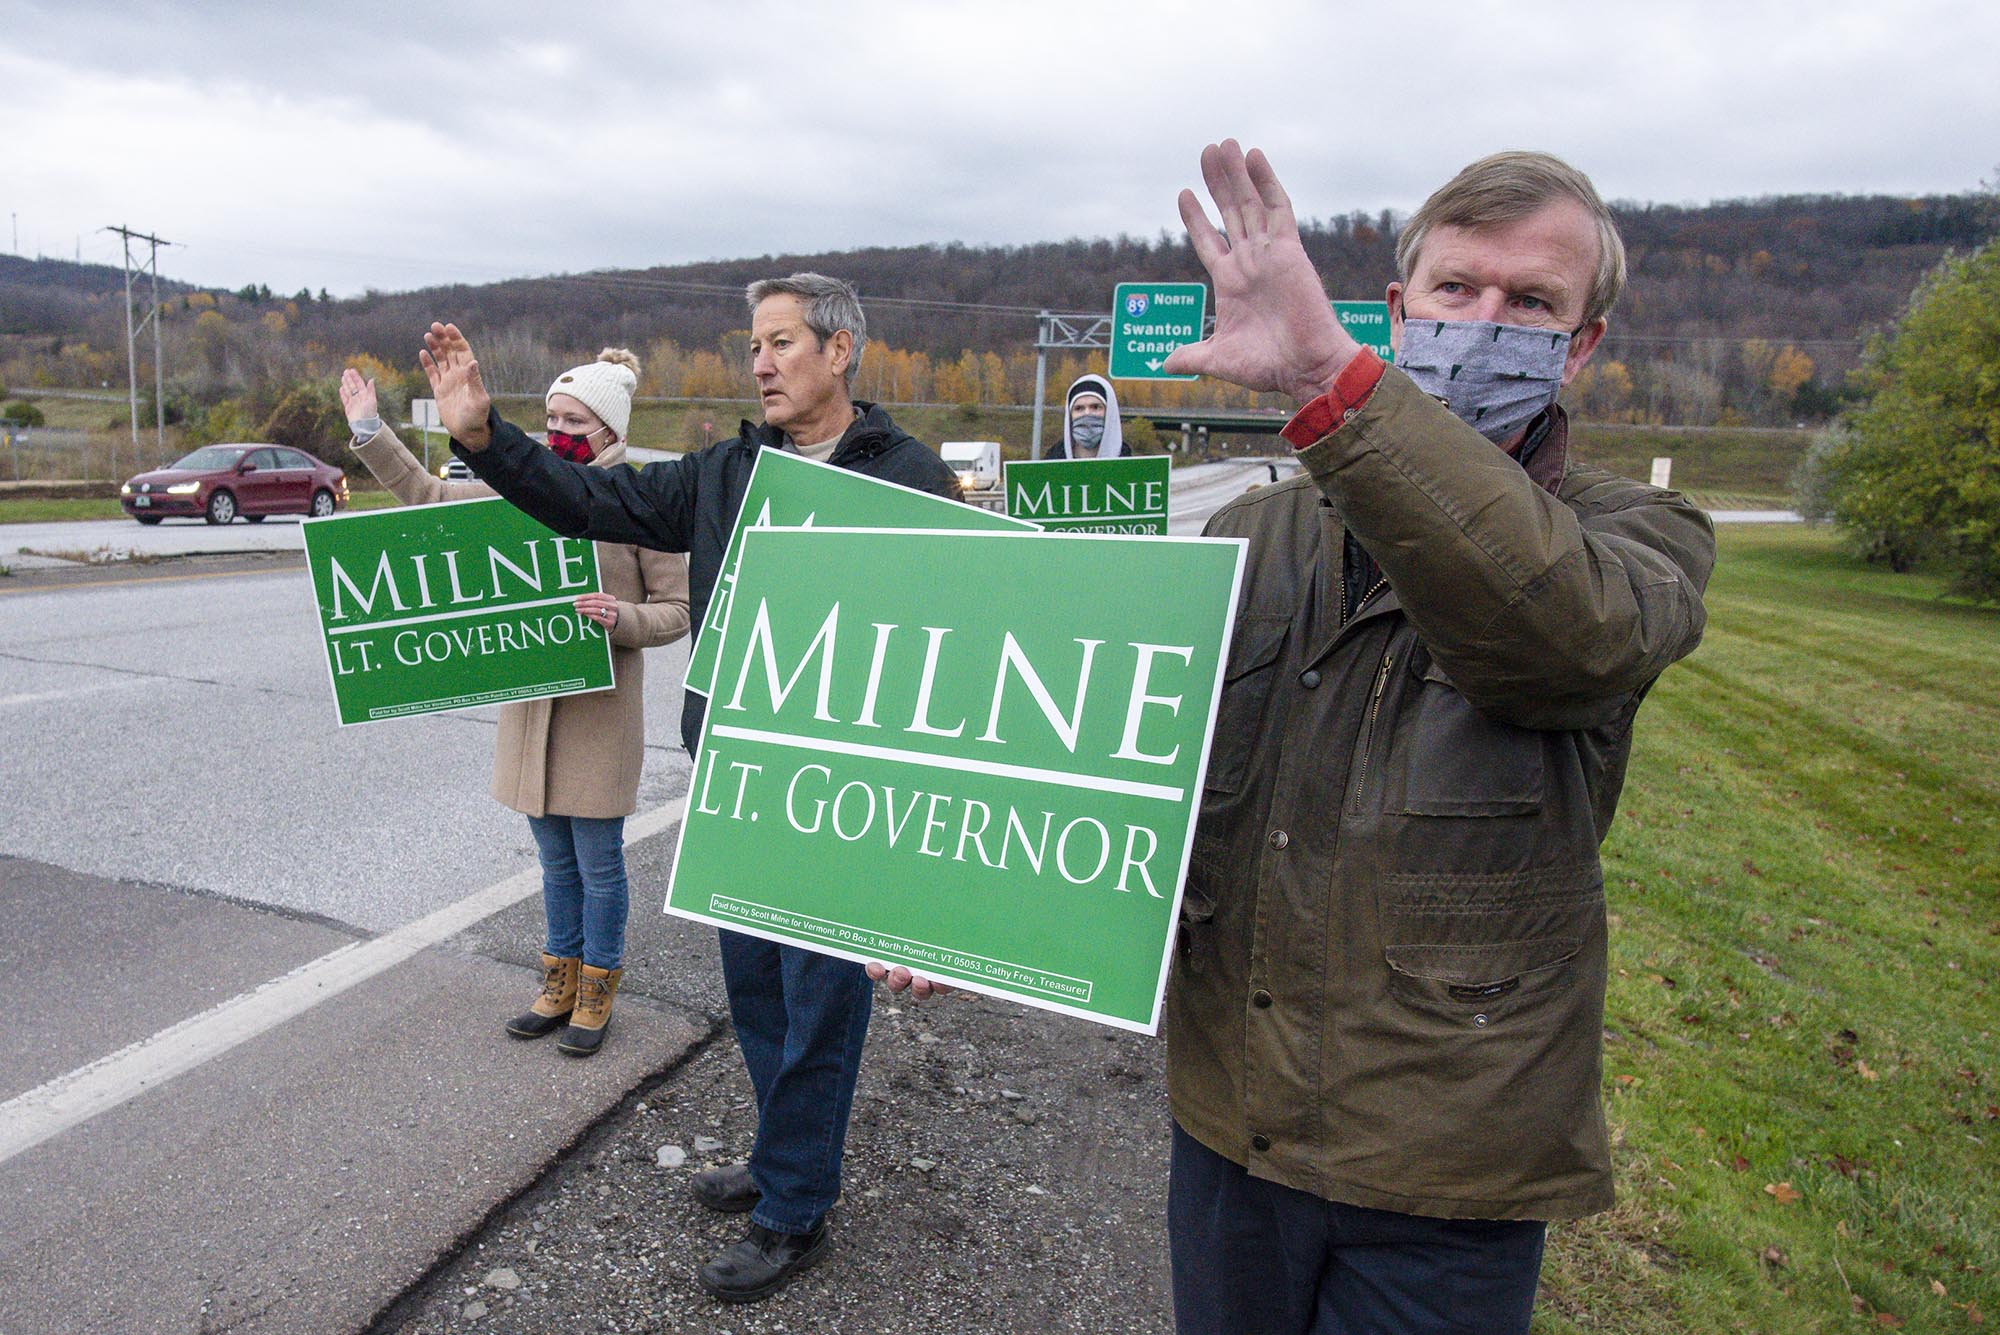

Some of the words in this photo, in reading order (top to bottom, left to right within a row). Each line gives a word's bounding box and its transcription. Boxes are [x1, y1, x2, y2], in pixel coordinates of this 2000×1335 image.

[1123, 322, 1192, 336] Swanton
[1128, 299, 1146, 313] 89
[1154, 293, 1195, 305] NORTH
[1341, 311, 1383, 324] SOUTH
[1012, 481, 1163, 516] MILNE
[329, 536, 589, 621] MILNE
[331, 640, 382, 676] LT.
[394, 612, 602, 666] GOVERNOR
[722, 596, 1196, 766] MILNE
[695, 749, 763, 821] LT.
[785, 764, 1164, 899] GOVERNOR
[713, 899, 729, 910] Paid
[730, 902, 740, 912] for
[741, 906, 750, 916] by
[750, 908, 770, 920] Scott
[771, 913, 790, 925] Milne
[791, 918, 802, 928] for
[839, 929, 851, 940] PO
[852, 933, 868, 943] Box
[878, 939, 902, 951] North
[941, 954, 953, 963] VT
[985, 964, 1012, 979] Cathy
[1040, 976, 1087, 995] Treasurer
